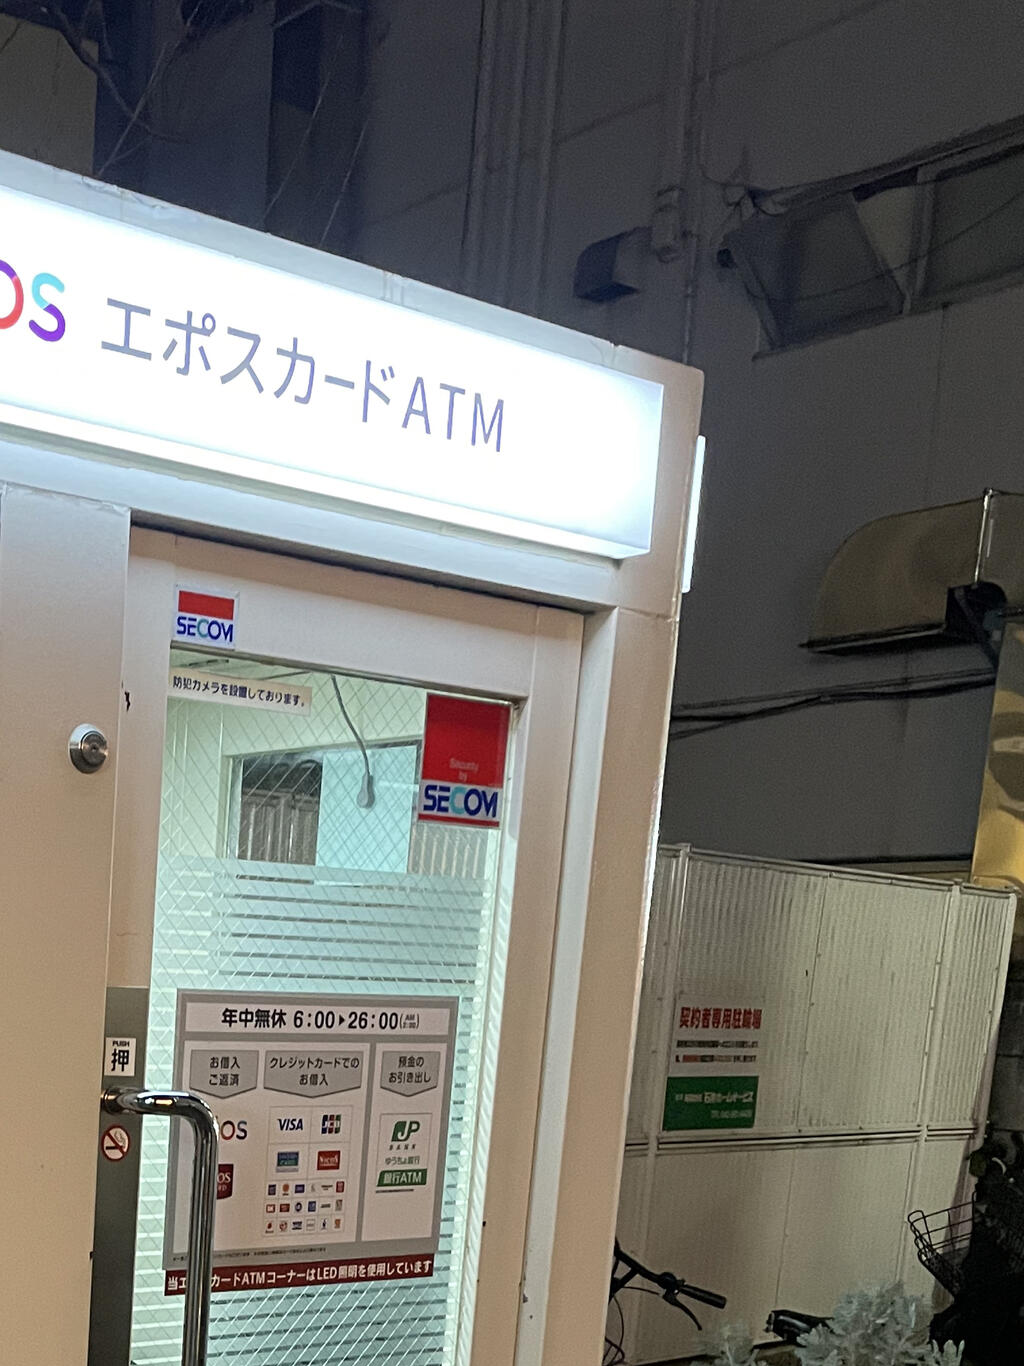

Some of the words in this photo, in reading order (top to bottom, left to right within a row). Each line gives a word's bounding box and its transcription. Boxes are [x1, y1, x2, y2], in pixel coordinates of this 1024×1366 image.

[101, 297, 505, 453] エポスカードATM
[176, 615, 233, 643] SECOM
[173, 674, 306, 708] 防犯カメラを設置しております。
[423, 784, 498, 818] SECOM
[221, 1007, 287, 1030] 年中無休
[293, 1010, 335, 1030] 6:00
[348, 1011, 398, 1030] 26:00
[111, 1048, 129, 1072] 押
[269, 1056, 360, 1070] クレジットカードでの
[398, 1056, 424, 1069] 預金の
[209, 1073, 239, 1086] ご返済
[388, 1071, 431, 1084] お引き出し
[277, 1118, 303, 1131] VISA
[383, 1172, 422, 1184] 銀行ATM
